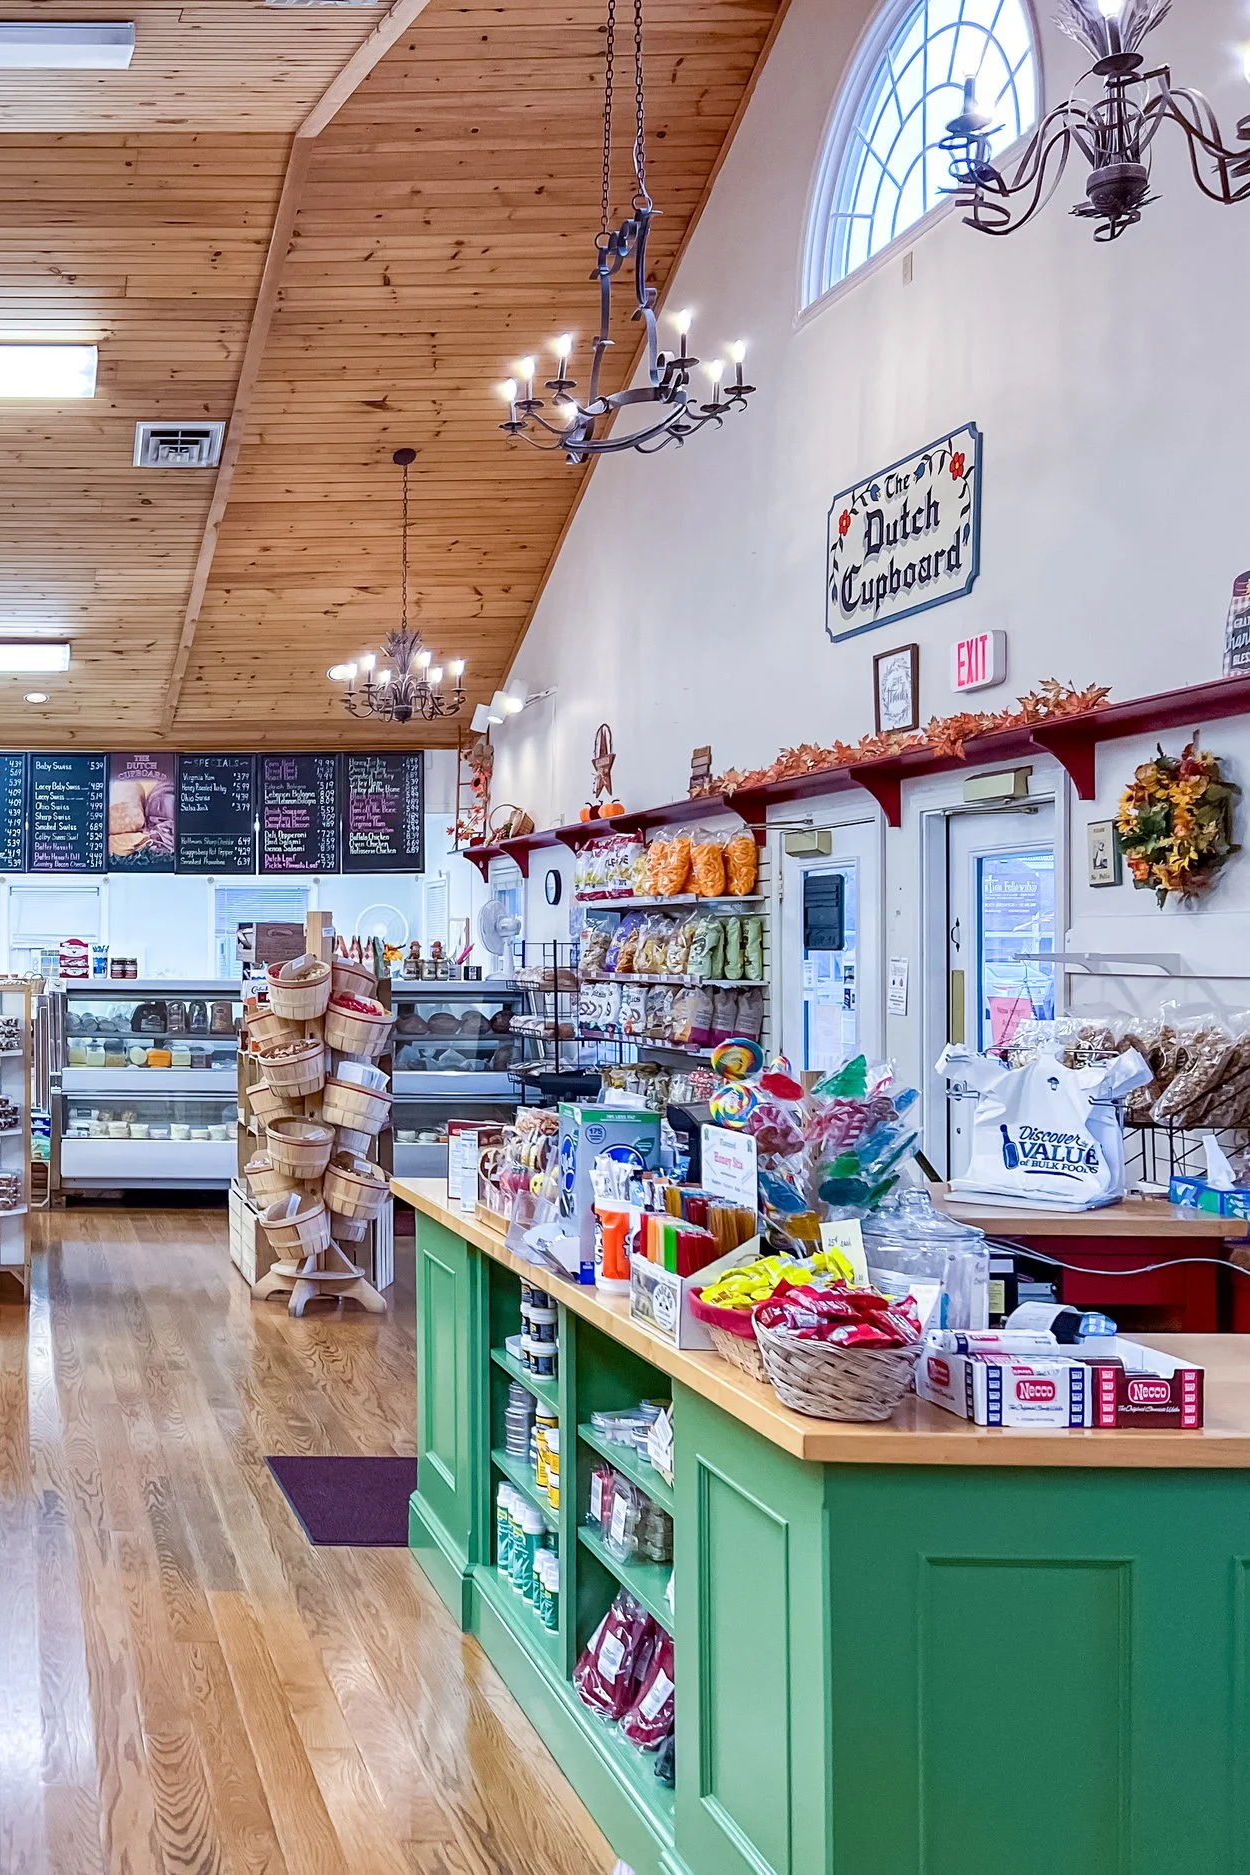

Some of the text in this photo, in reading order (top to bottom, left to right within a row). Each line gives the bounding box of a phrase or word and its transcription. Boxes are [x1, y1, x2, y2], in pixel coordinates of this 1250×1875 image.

[884, 472, 911, 500] The
[863, 486, 940, 558] Dutch
[841, 532, 962, 613] Cupboard
[957, 634, 989, 687] EXIT
[35, 761, 52, 772] Baby
[52, 762, 72, 770] Swiss
[117, 770, 168, 780] CUPBOARD
[126, 762, 158, 770] DUTCH
[1019, 1125, 1083, 1147] Discover
[1018, 1141, 1100, 1166] VALUE
[1019, 1158, 1030, 1167] of
[1031, 1160, 1060, 1171] BULK
[1019, 1382, 1053, 1400] Necco
[1133, 1383, 1167, 1401] Necco
